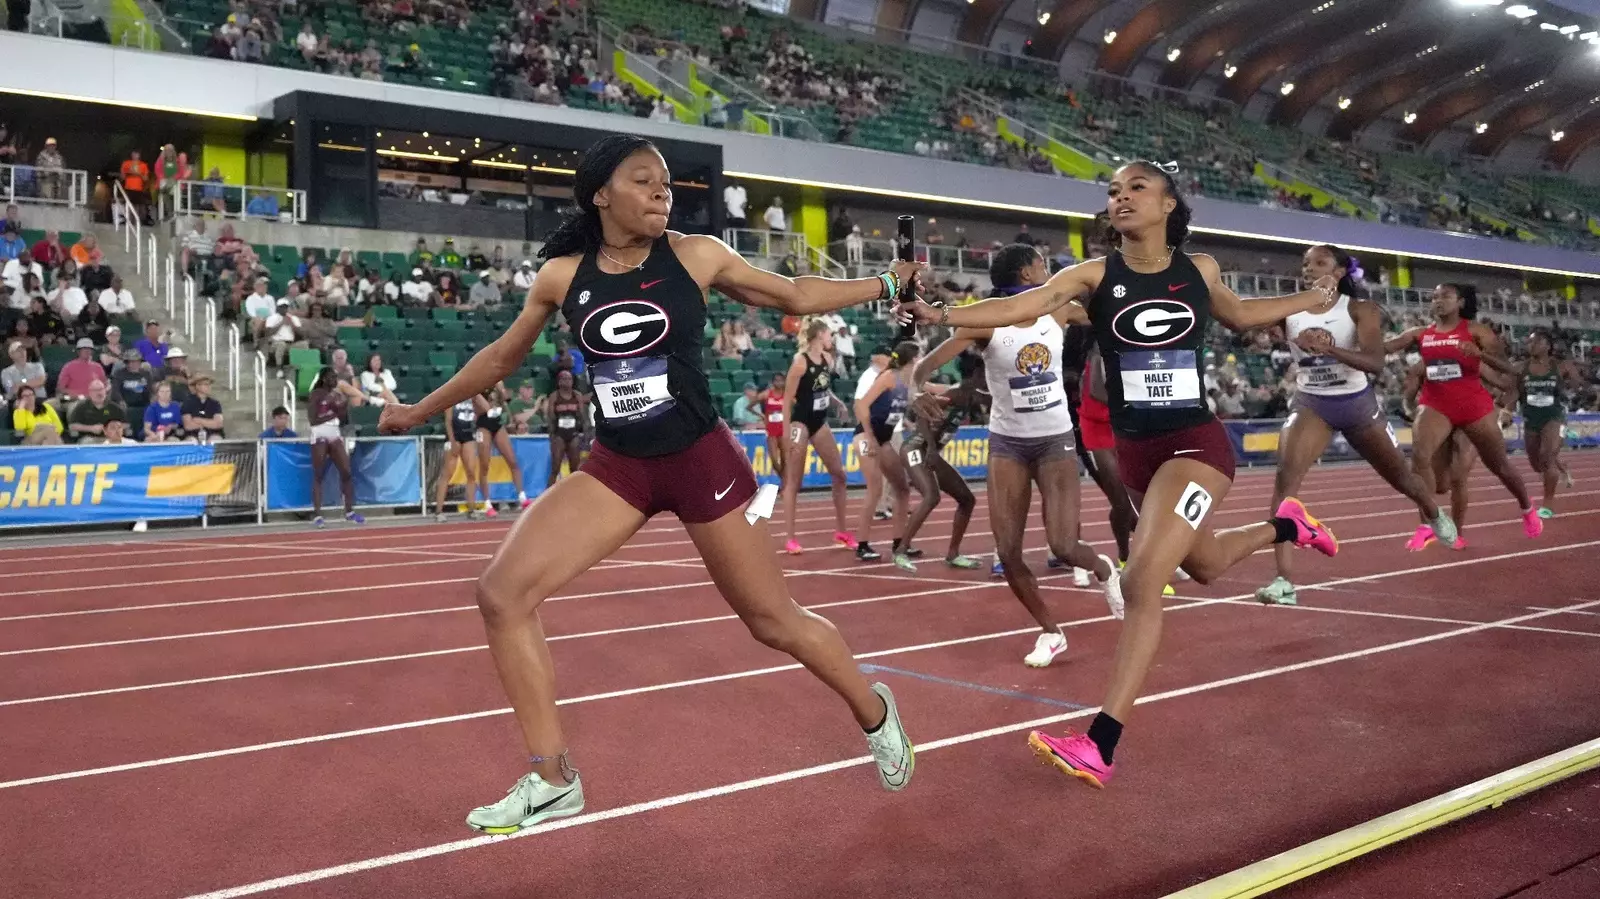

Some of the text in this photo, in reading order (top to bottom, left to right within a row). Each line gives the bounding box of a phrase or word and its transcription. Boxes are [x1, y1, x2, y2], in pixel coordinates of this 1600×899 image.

[1112, 284, 1127, 298] SEC
[1144, 373, 1174, 383] HALEY
[611, 382, 645, 397] SYDNEY
[1021, 385, 1052, 397] MICHAELA
[1146, 385, 1174, 398] TATE
[612, 395, 654, 414] HARRIS
[1028, 395, 1048, 405] ROSE
[791, 428, 798, 442] 9
[861, 441, 869, 454] 2
[910, 451, 918, 463] 4
[1184, 490, 1208, 522] 6
